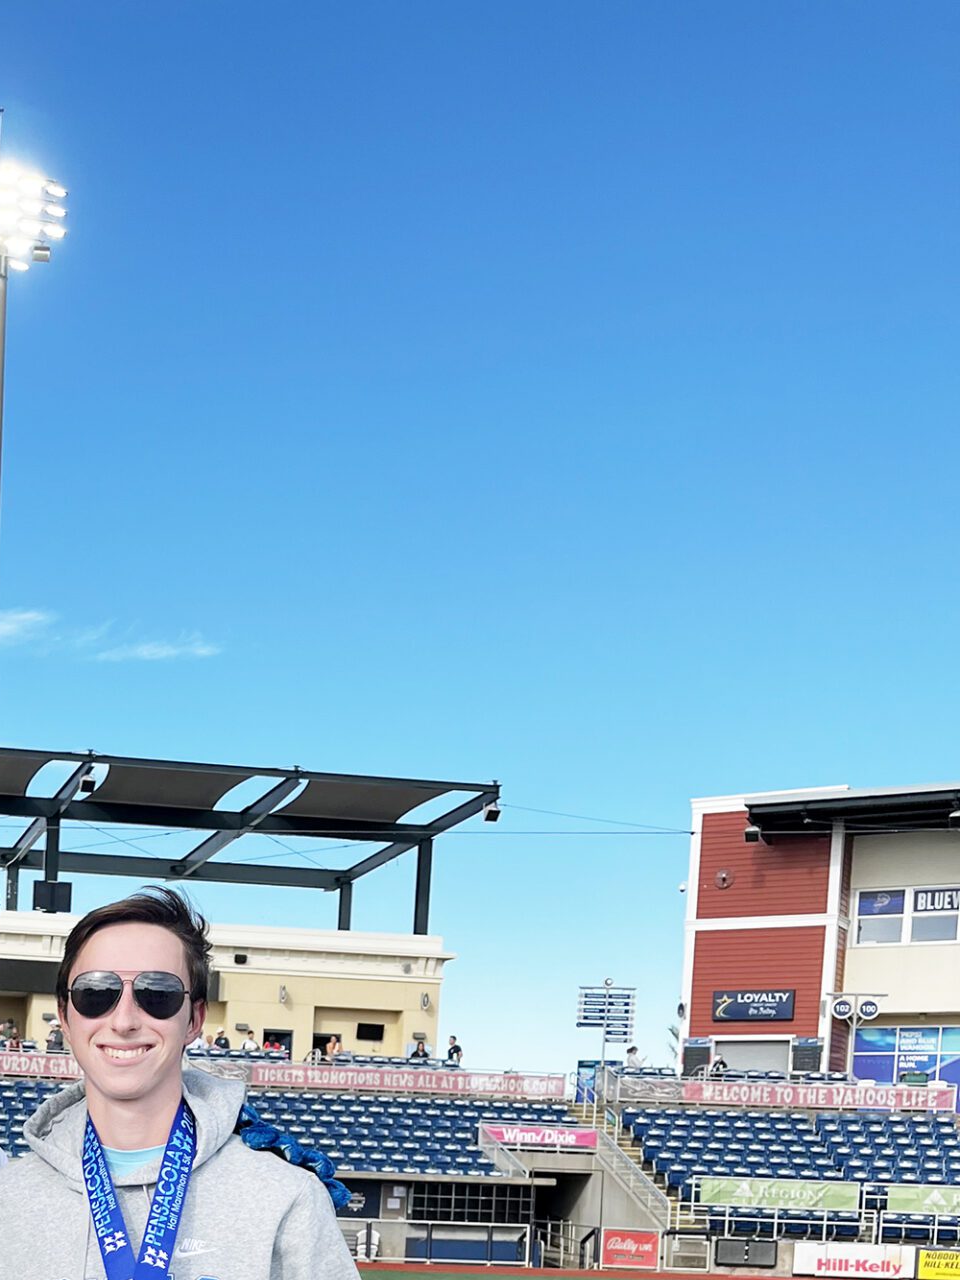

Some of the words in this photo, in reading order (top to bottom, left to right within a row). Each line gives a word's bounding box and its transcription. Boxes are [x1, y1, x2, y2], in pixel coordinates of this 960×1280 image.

[737, 993, 789, 1003] LOYALTY
[835, 1004, 850, 1013] 102
[861, 1004, 876, 1013] 100
[50, 1058, 84, 1075] GAM
[257, 1068, 304, 1083] TICKETS
[307, 1070, 381, 1086] PROMOTIONS
[384, 1074, 414, 1087] NEWS
[417, 1075, 438, 1088] ALL
[441, 1076, 455, 1089] AT
[701, 1084, 771, 1102] WELCOME
[775, 1086, 792, 1102] TO
[797, 1087, 827, 1104] THE
[832, 1087, 896, 1106] WAHOOS
[899, 1089, 938, 1106] LIFE
[145, 1151, 183, 1247] PENSACOLA
[171, 1173, 188, 1213] Marathon
[167, 1211, 179, 1231] Half
[816, 1258, 902, 1276] Hill-Kelly
